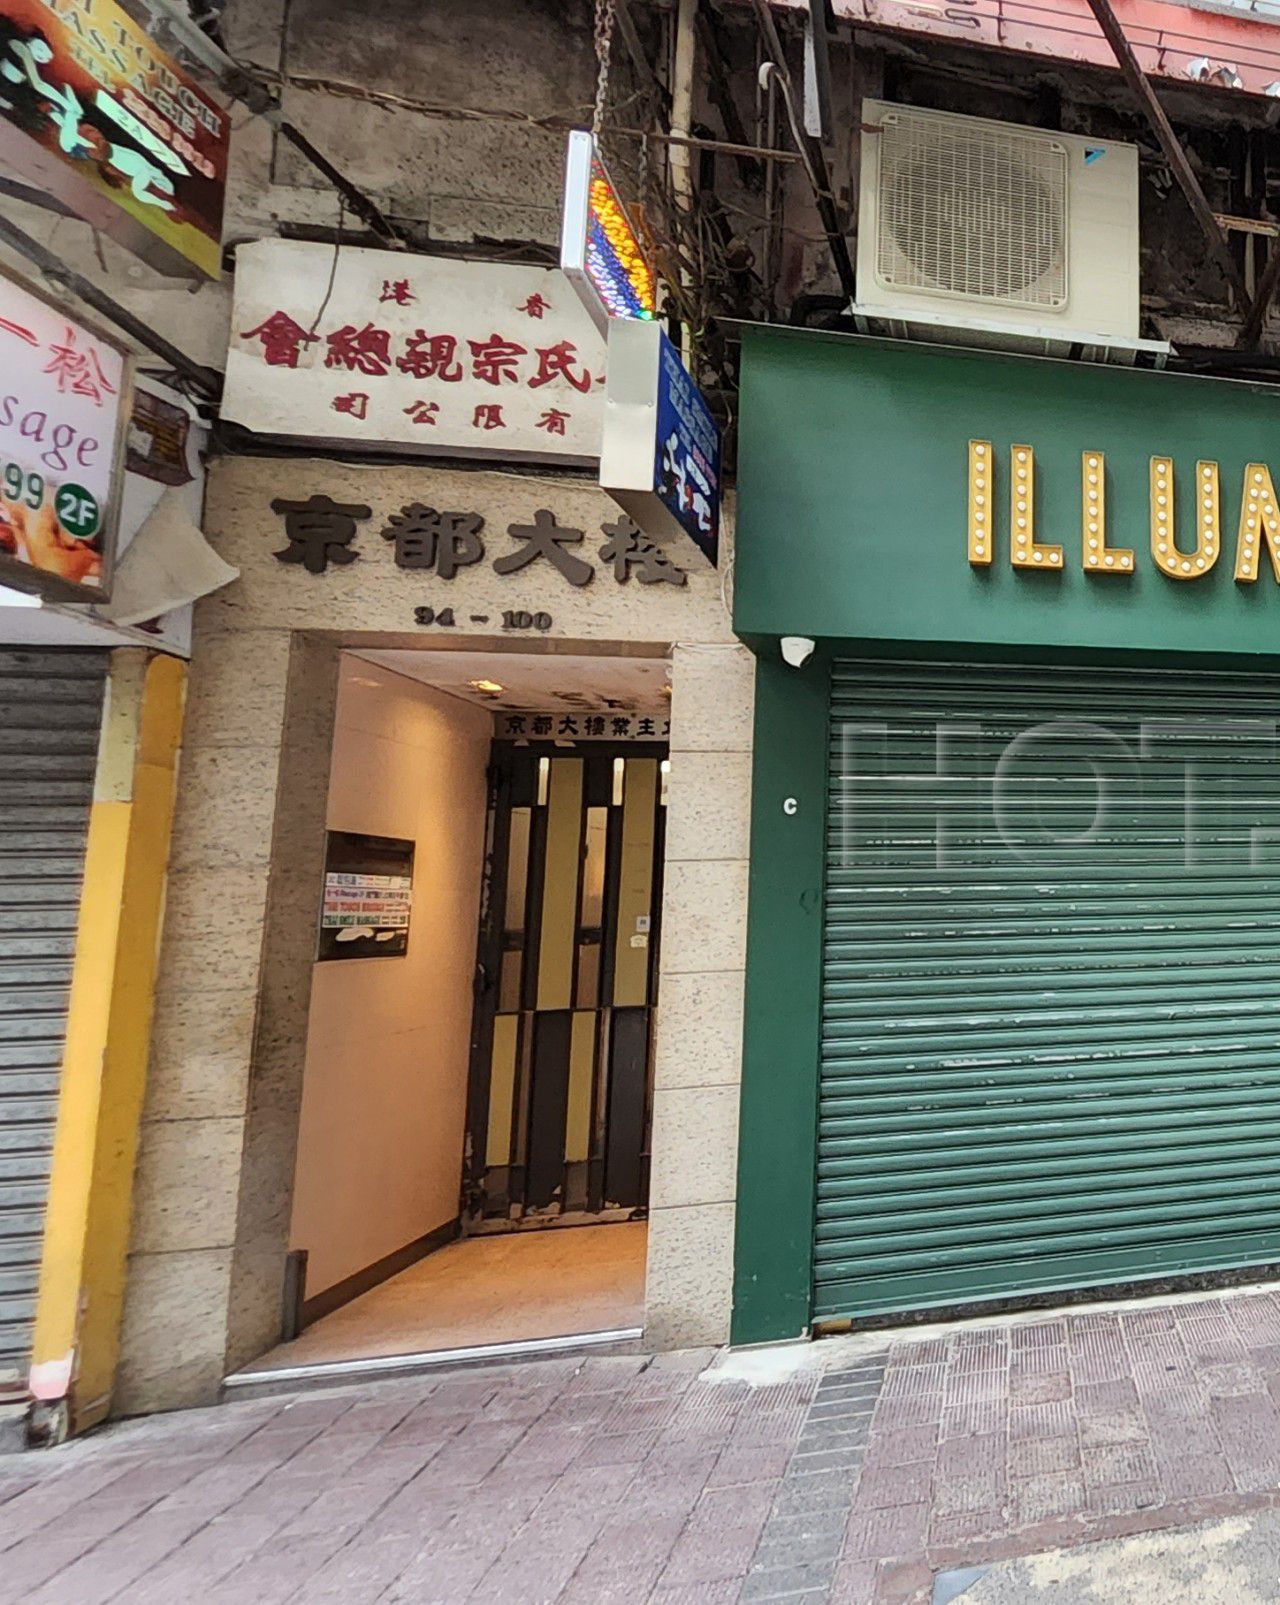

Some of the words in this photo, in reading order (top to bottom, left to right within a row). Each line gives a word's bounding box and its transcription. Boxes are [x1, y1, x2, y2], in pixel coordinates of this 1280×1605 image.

[44, 0, 196, 140] ASSAGE
[240, 311, 606, 393] 氏宗親總會
[59, 491, 96, 528] 2F
